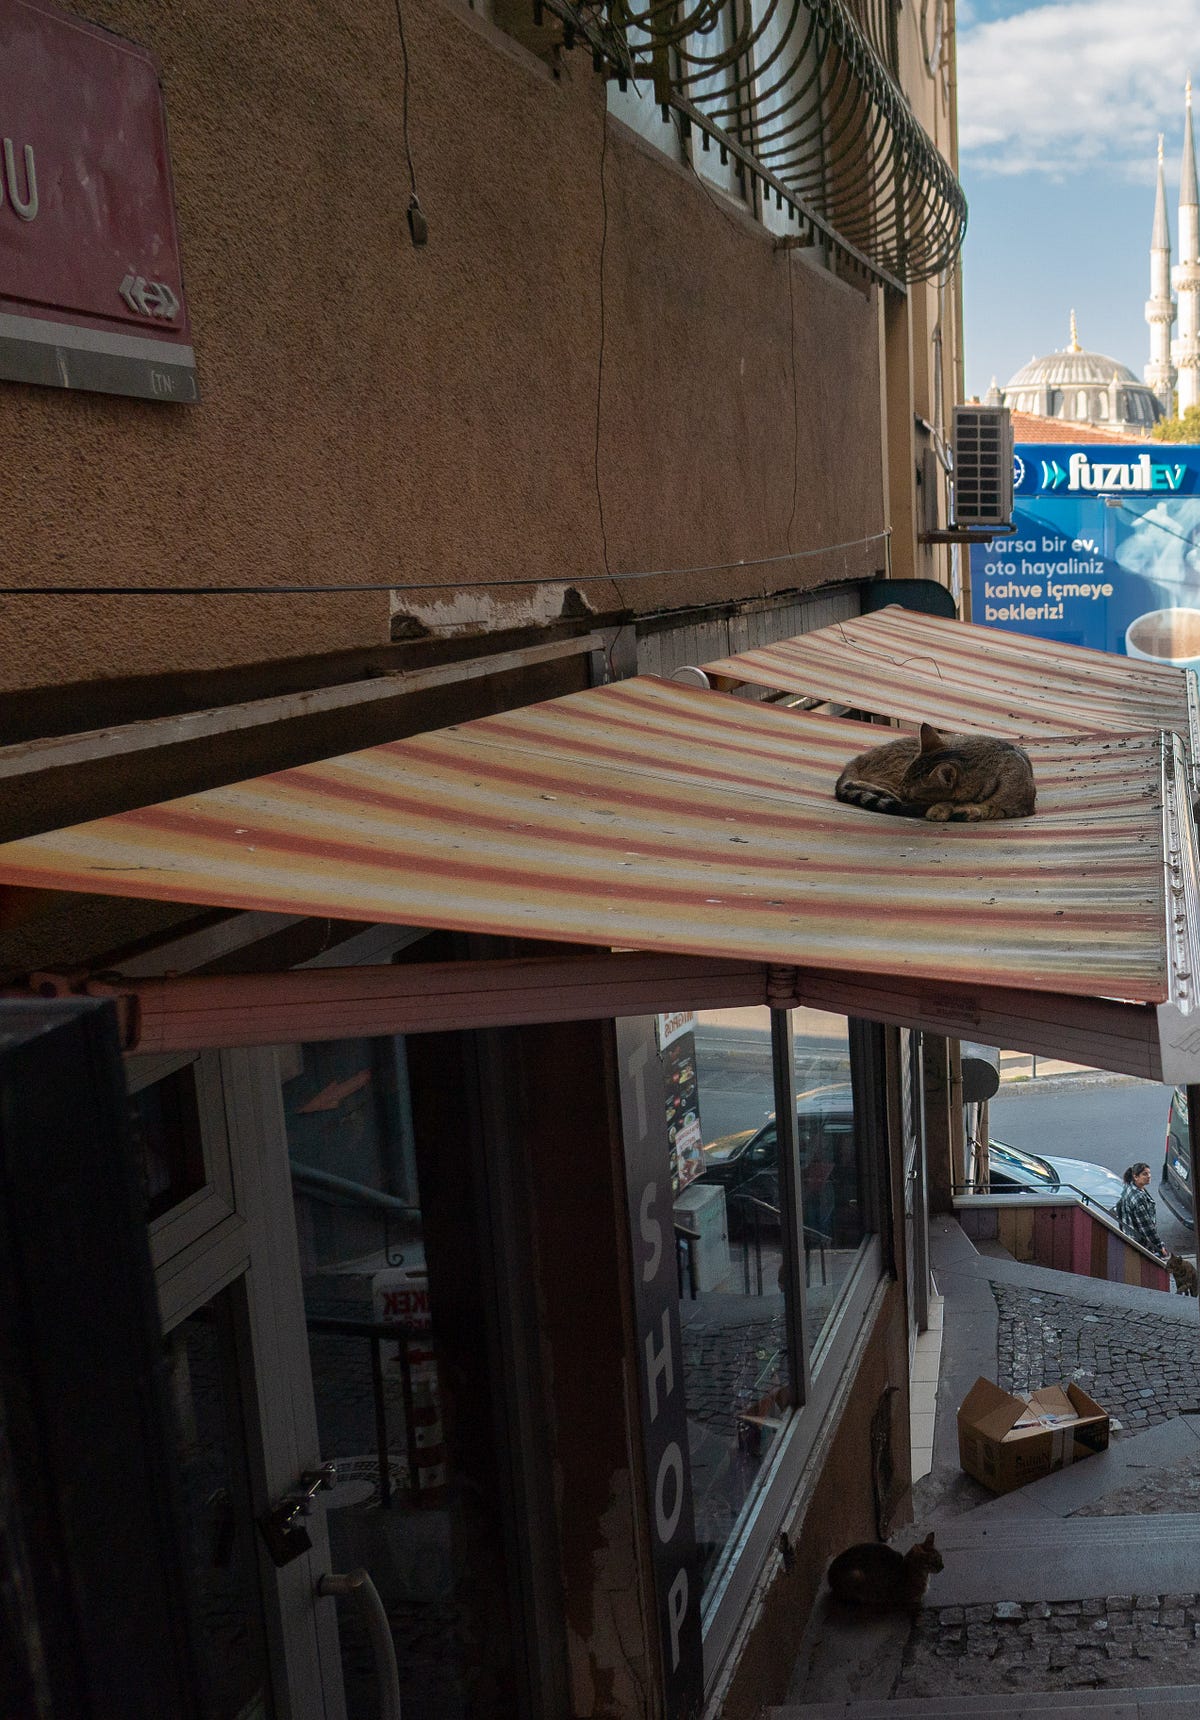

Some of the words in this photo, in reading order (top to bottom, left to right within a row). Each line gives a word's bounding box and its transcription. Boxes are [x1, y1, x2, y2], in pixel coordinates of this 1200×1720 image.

[0, 137, 39, 222] U
[1042, 536, 1067, 552] bir
[1071, 538, 1100, 555] ev,
[984, 559, 1016, 576] oto
[1021, 558, 1104, 579] hayaliniz
[984, 581, 1043, 599] kahve
[1047, 580, 1114, 602] içmeye
[984, 602, 1064, 621] bekleriz!
